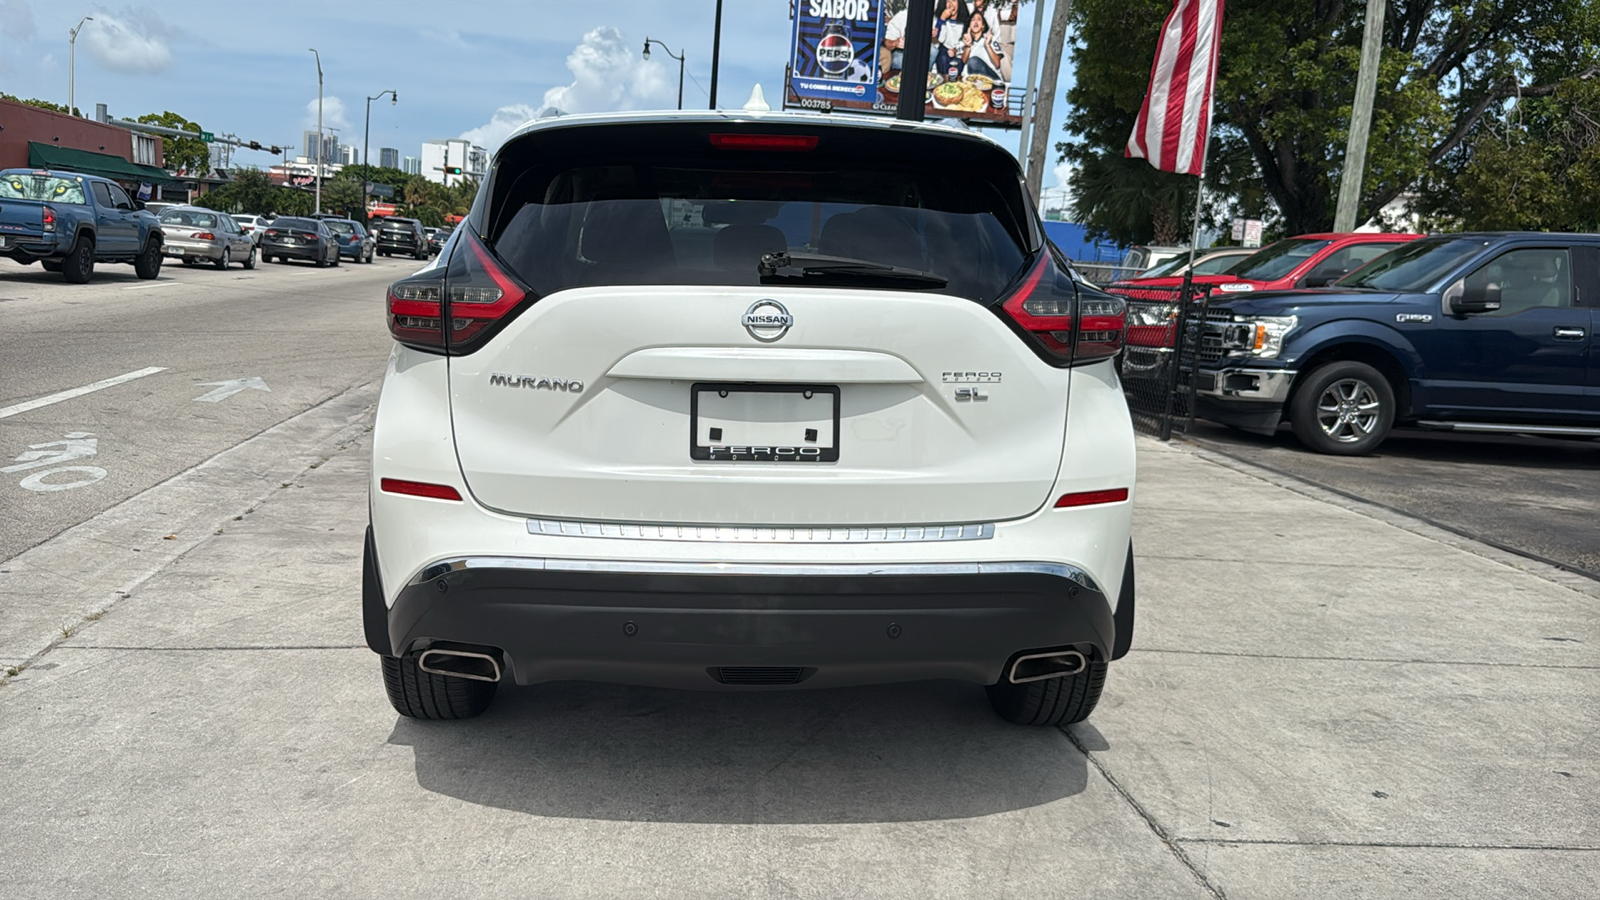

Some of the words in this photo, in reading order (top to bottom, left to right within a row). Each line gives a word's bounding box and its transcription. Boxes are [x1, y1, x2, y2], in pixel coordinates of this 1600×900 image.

[808, 0, 870, 21] SABOR
[819, 48, 852, 59] PEPSI
[809, 83, 832, 91] COMIDA
[801, 98, 831, 110] 003785
[747, 315, 788, 324] NISSAN
[490, 372, 584, 394] MURANO
[954, 387, 989, 403] SL
[710, 446, 820, 455] FERCO
